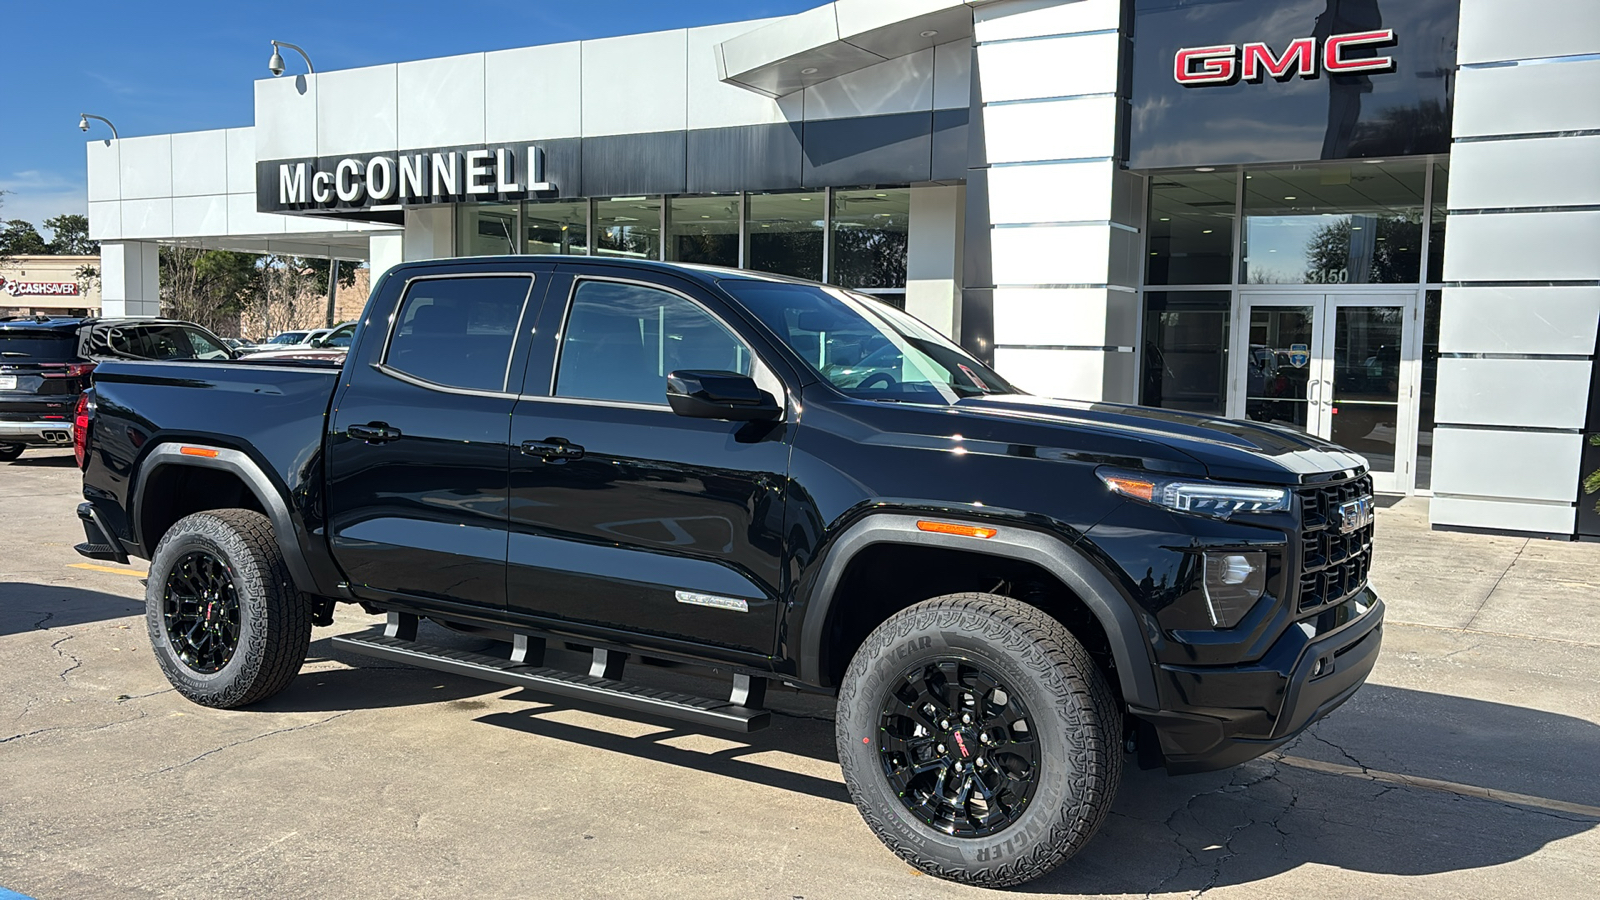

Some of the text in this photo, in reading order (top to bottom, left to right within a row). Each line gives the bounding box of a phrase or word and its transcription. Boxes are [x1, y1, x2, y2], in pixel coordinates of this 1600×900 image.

[1174, 28, 1394, 84] GMC
[279, 146, 551, 205] McCONNELL
[19, 283, 75, 294] CASHSAVER
[1307, 268, 1349, 284] 3150
[855, 636, 932, 729] GOODYEAR
[878, 801, 926, 847] TERRITORY
[977, 752, 1062, 862] WRANGLER
